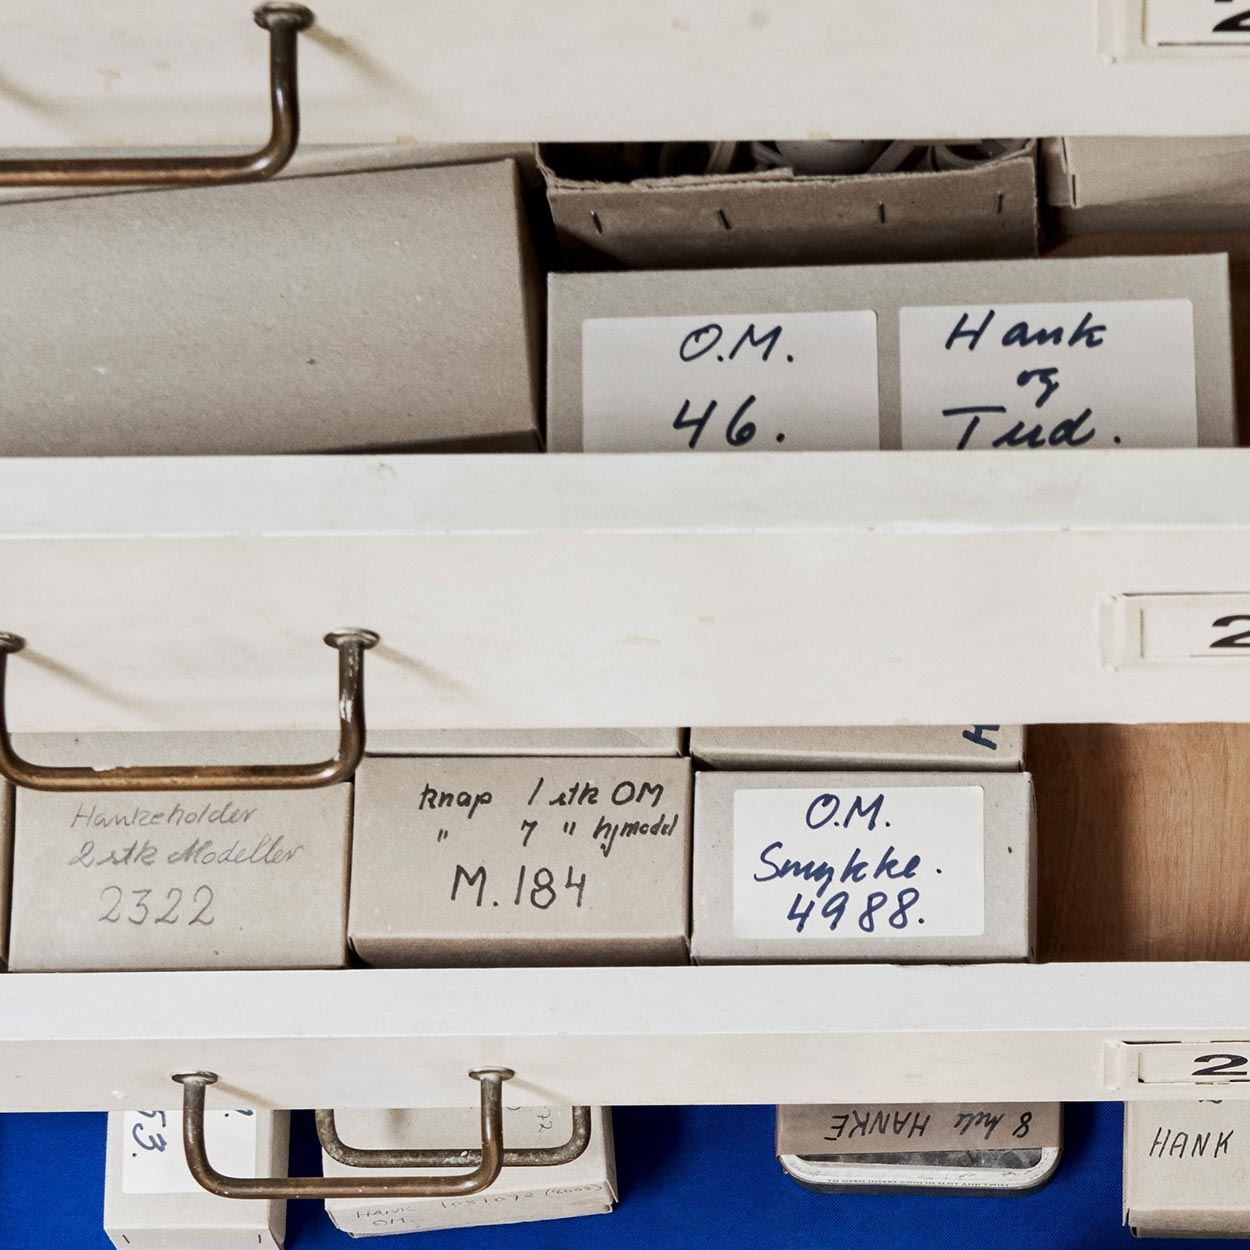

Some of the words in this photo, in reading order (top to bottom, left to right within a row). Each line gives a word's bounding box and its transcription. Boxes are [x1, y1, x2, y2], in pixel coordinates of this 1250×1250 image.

[680, 324, 795, 363] O.M.
[945, 309, 1107, 350] Hank
[672, 395, 786, 448] 46.
[611, 781, 664, 807] OM
[806, 793, 890, 830] O.M.
[98, 884, 216, 926] 2322
[787, 887, 925, 932] 4988.
[1150, 1126, 1234, 1158] HANK
